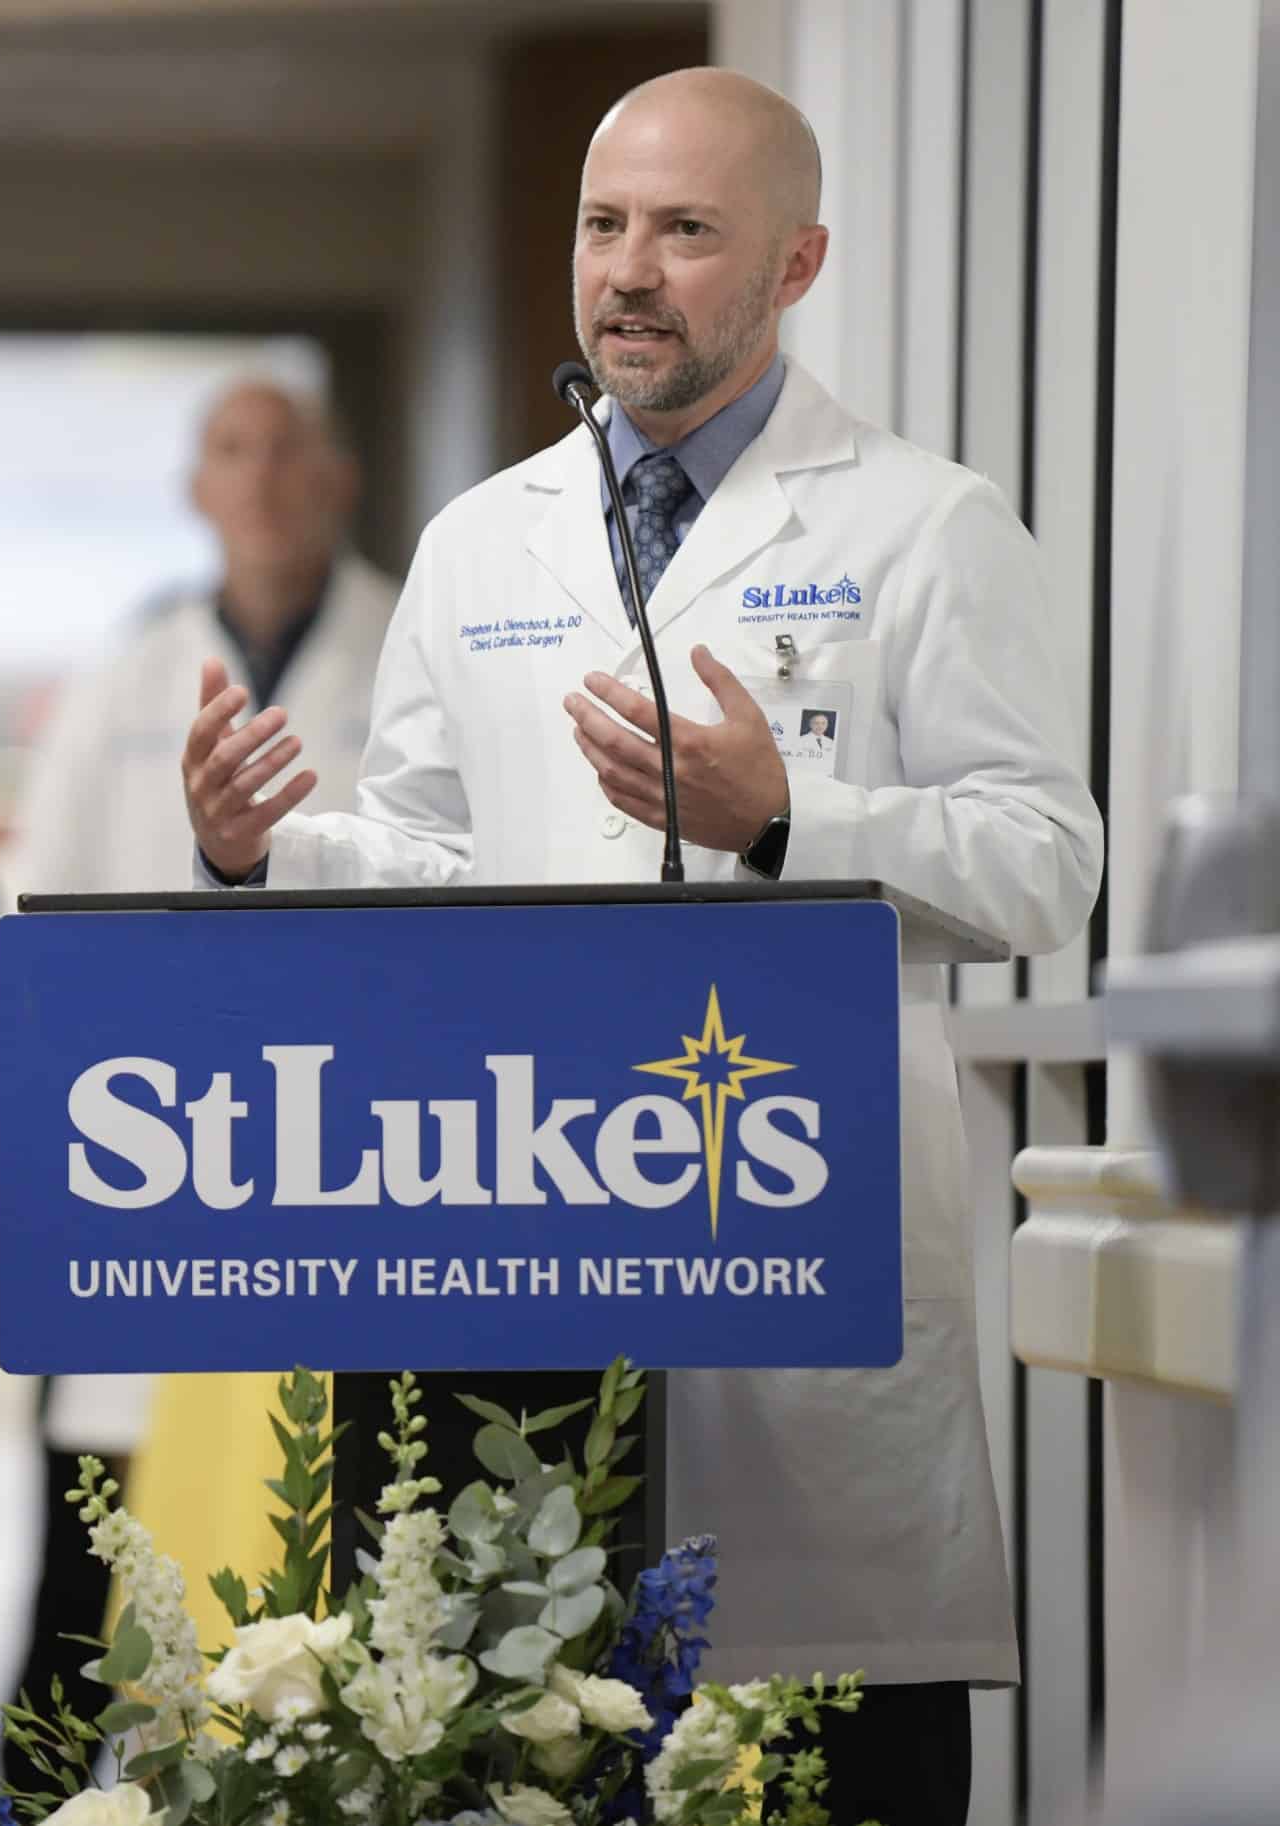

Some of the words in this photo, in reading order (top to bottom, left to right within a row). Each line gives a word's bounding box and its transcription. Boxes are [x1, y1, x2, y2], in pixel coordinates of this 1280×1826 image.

[738, 613, 785, 624] UNIVERSITY
[787, 612, 819, 621] HEALTH
[820, 610, 861, 620] NETWORK
[493, 633, 524, 648] Cardiac
[527, 633, 564, 648] Surgery
[68, 1259, 358, 1298] UNIVERSITY
[376, 1257, 559, 1297] HEALTH
[579, 1256, 827, 1296] NETWORK
